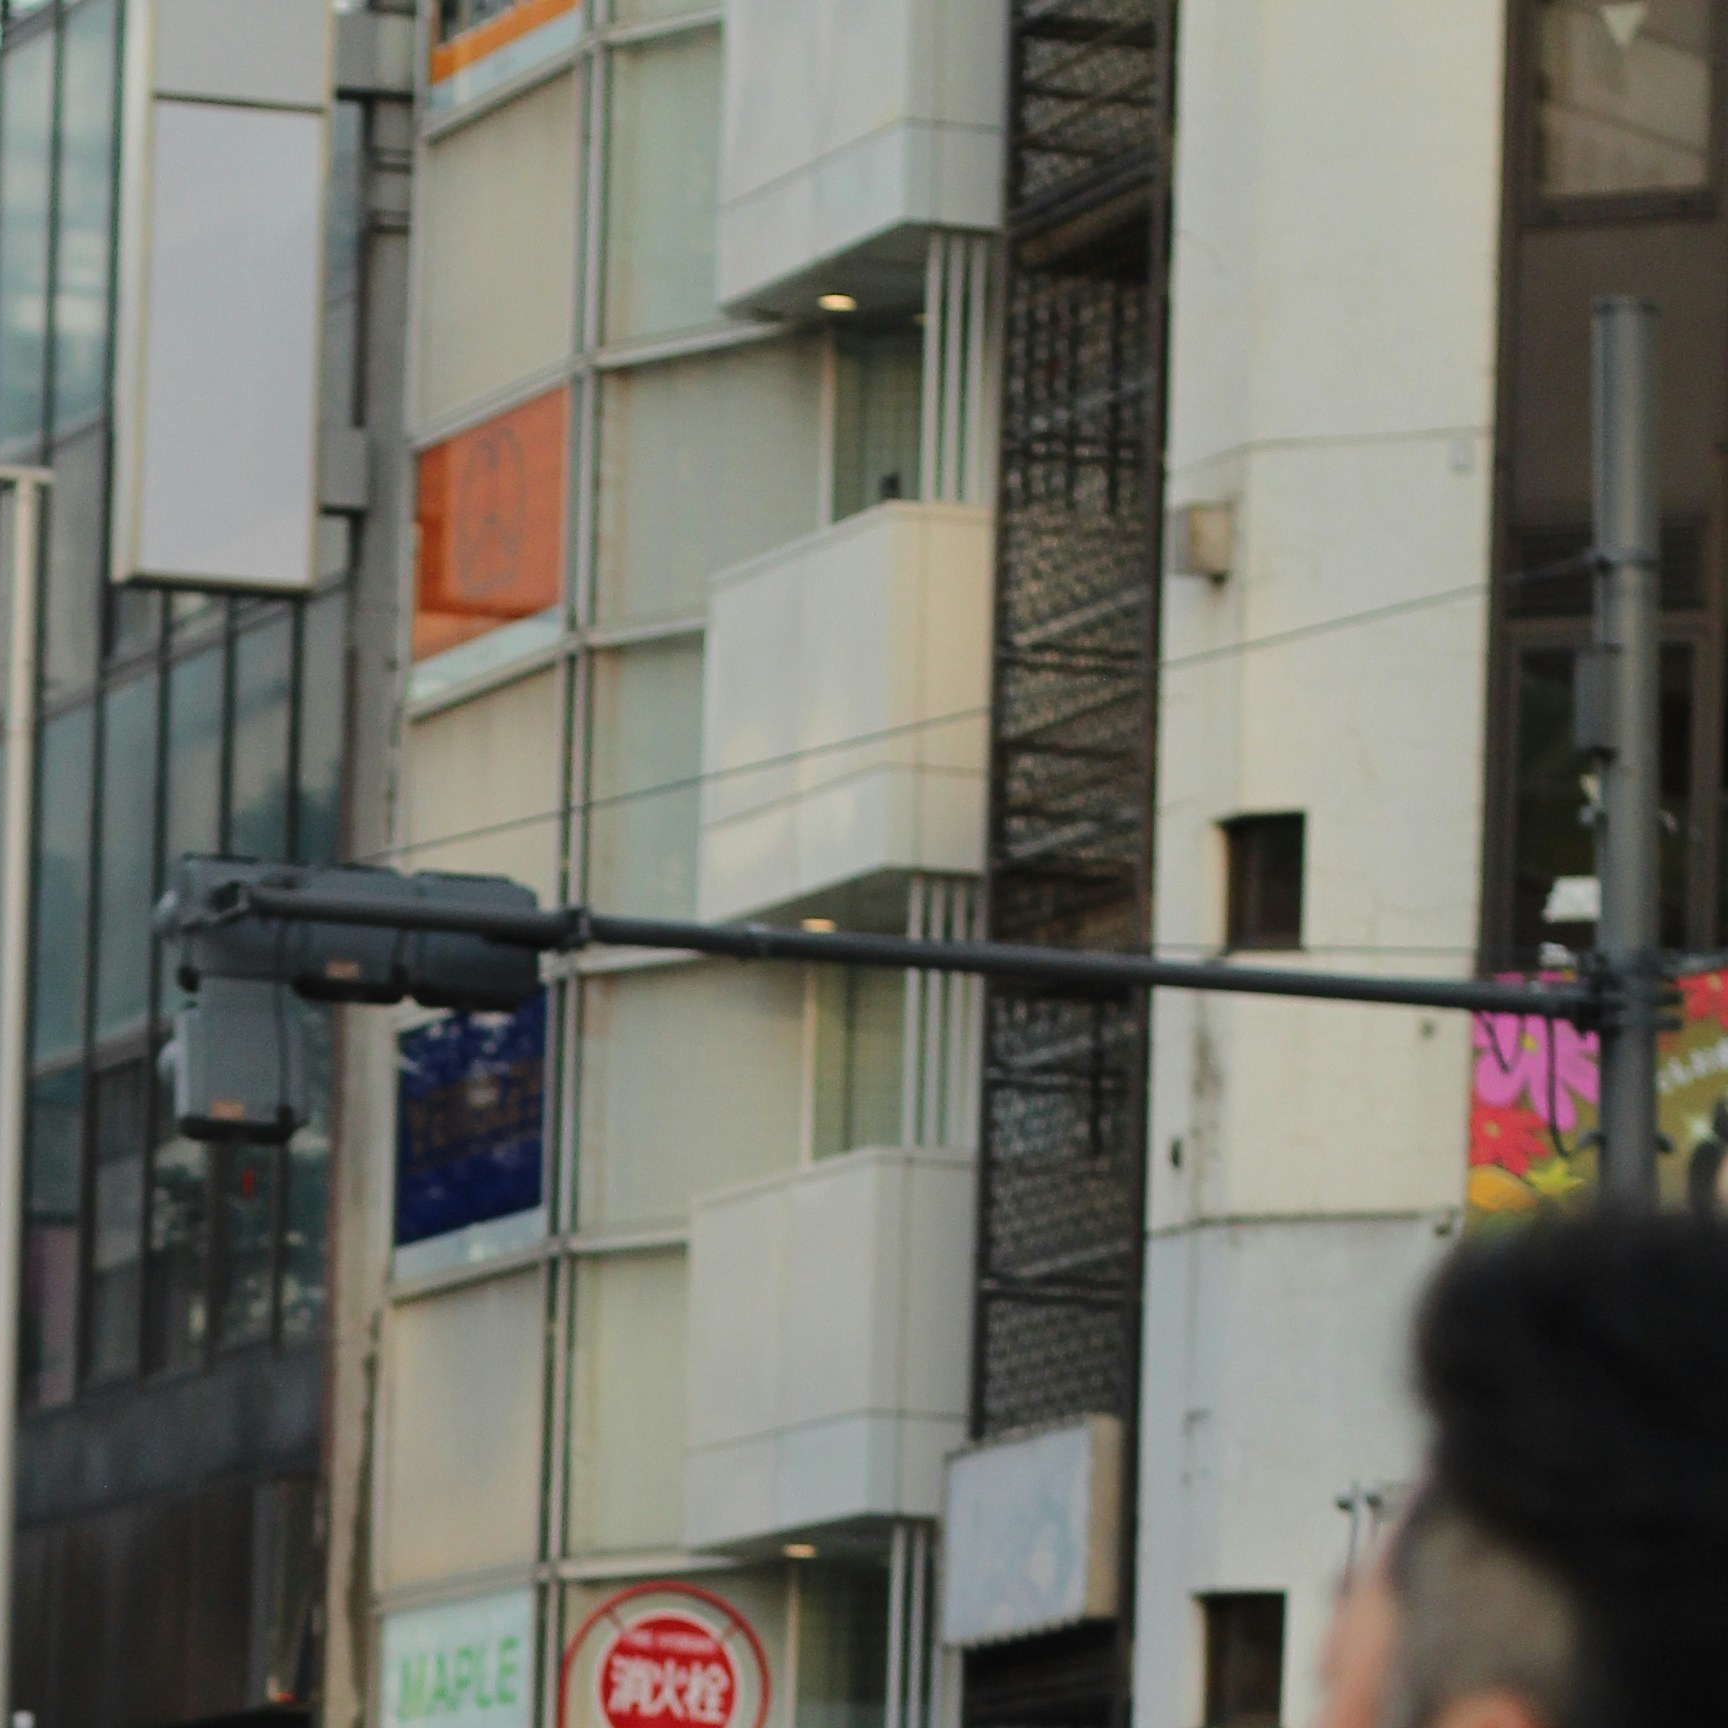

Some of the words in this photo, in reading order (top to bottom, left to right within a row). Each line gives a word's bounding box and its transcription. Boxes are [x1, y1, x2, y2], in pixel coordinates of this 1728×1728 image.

[398, 1634, 519, 1722] MAPLE
[607, 1653, 730, 1726] 消火栓
